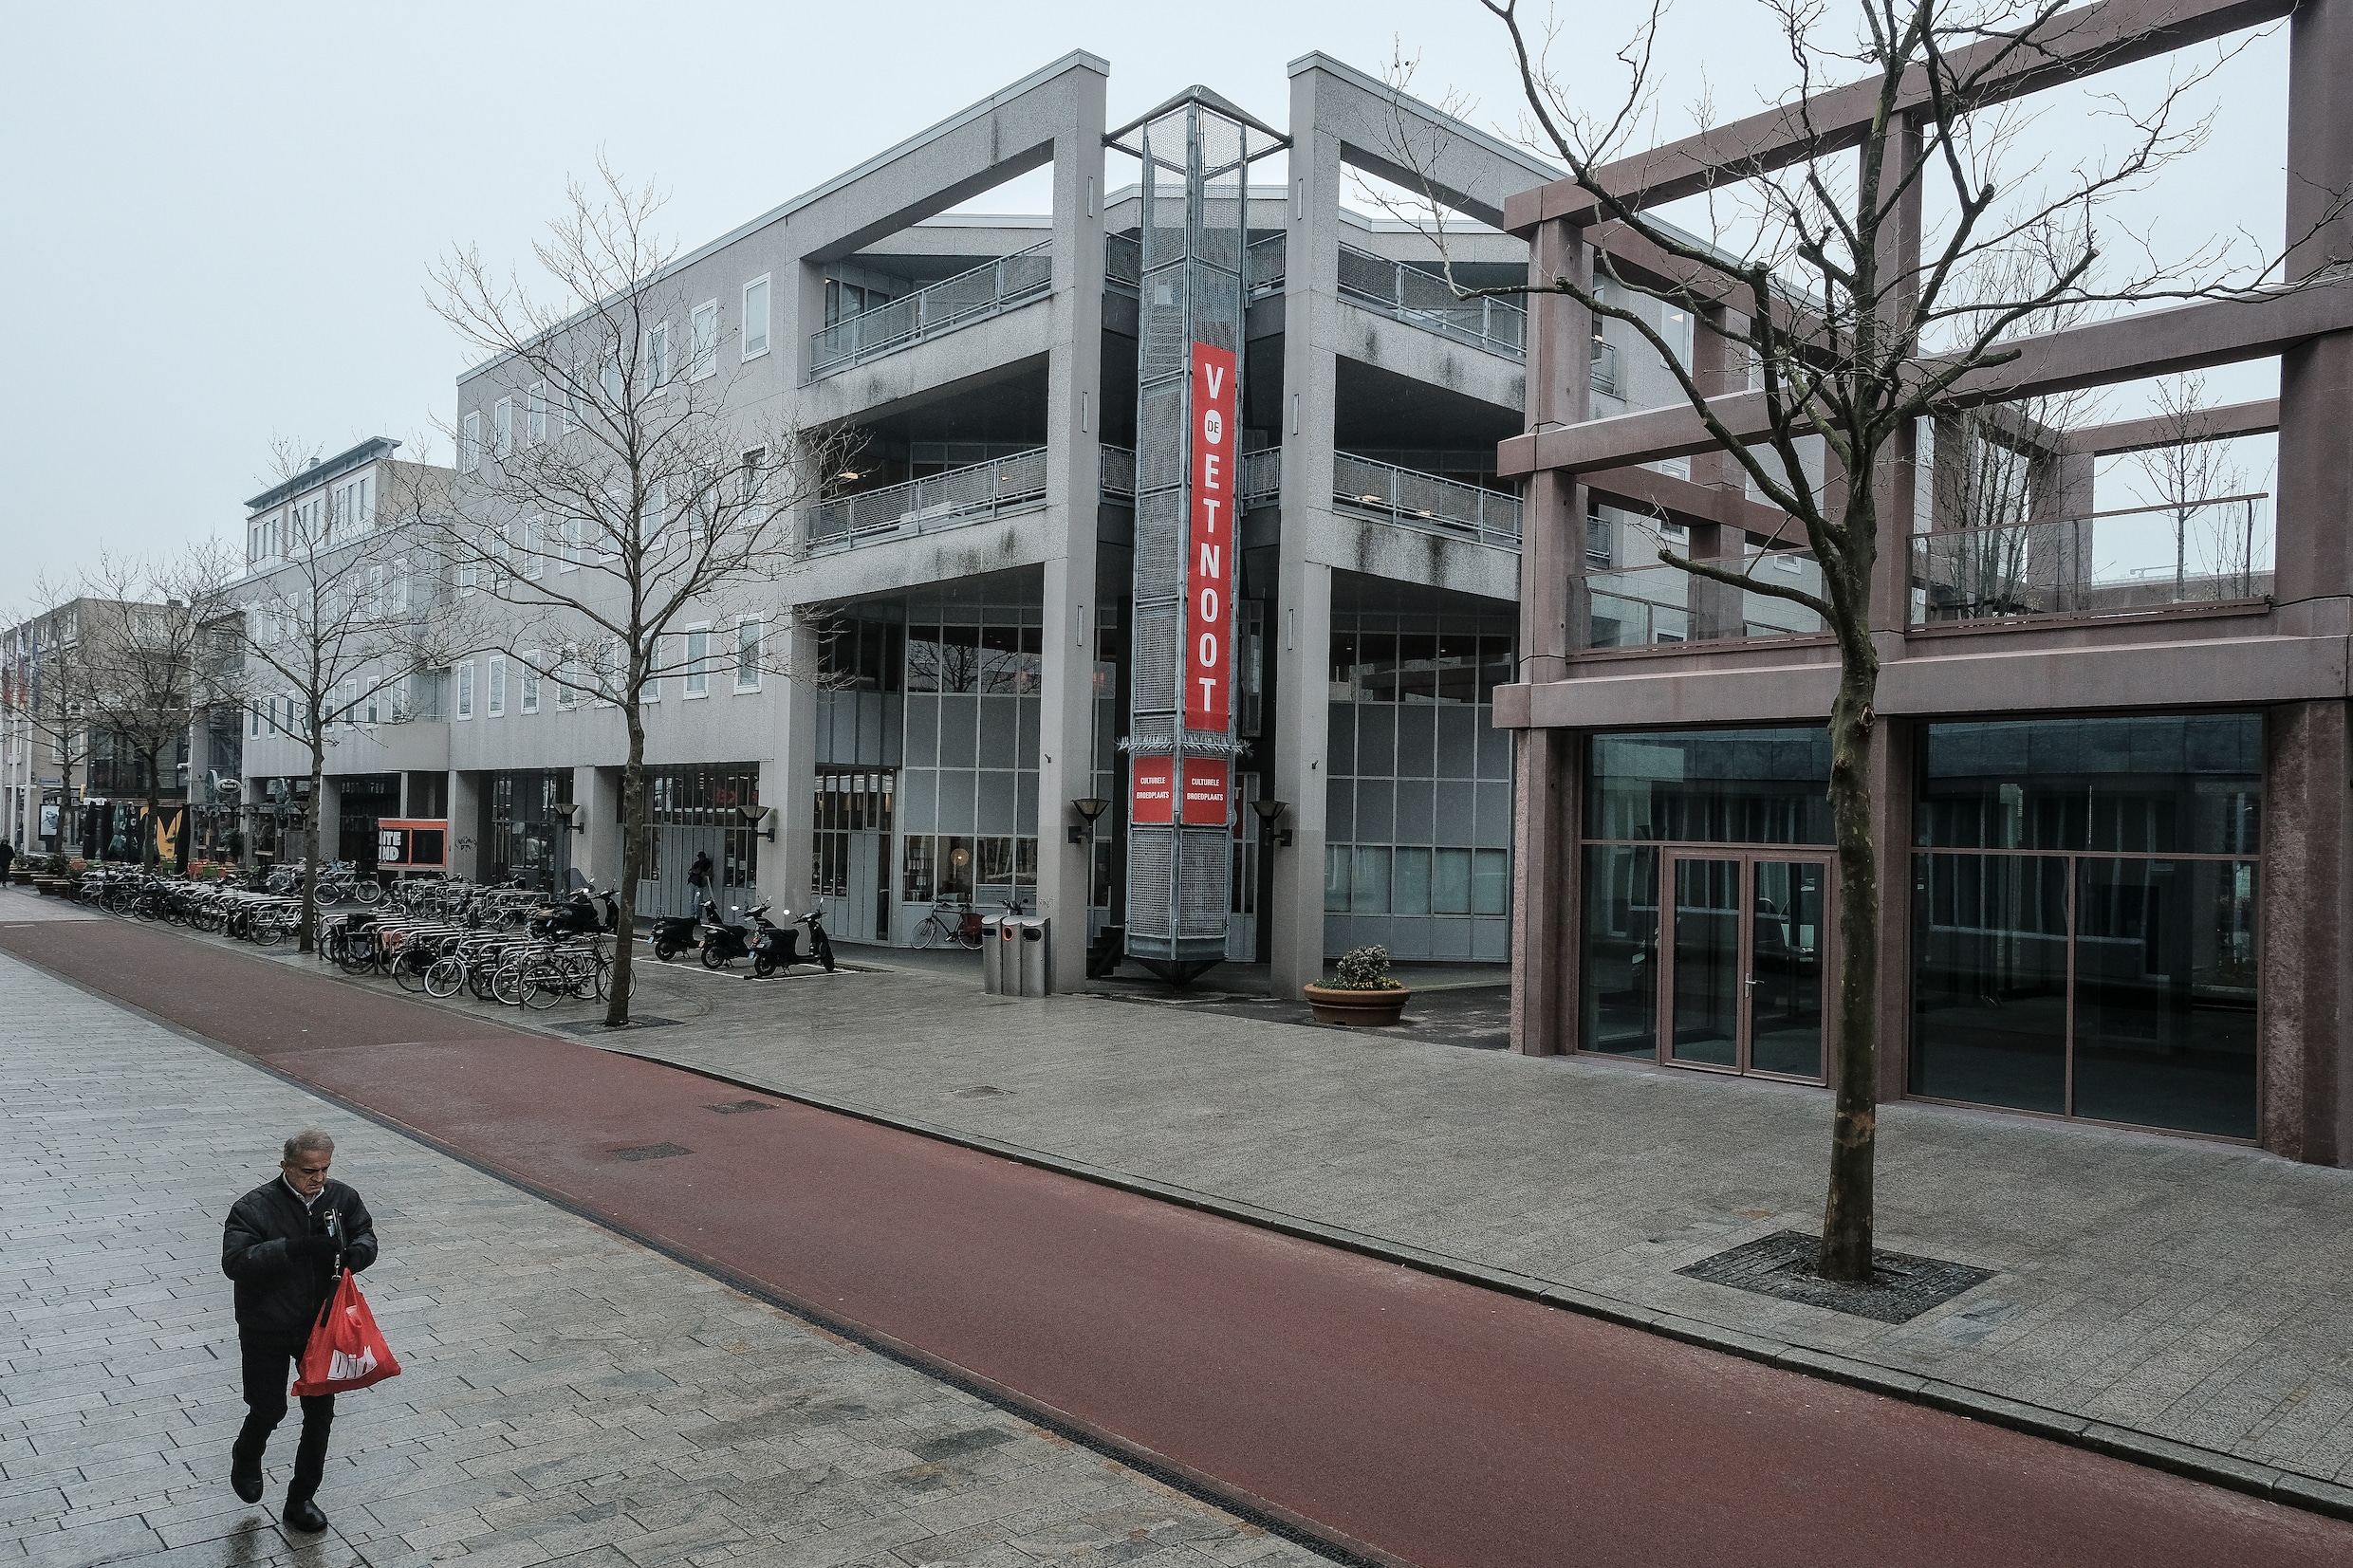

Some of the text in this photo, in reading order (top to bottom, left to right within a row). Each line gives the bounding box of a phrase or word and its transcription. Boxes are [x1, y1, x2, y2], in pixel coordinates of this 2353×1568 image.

[1207, 419, 1219, 434] DE
[1191, 778, 1220, 786] CULTURELE
[1136, 791, 1170, 800] BROEDPLAATS
[1187, 793, 1224, 802] BROEDPLAATS
